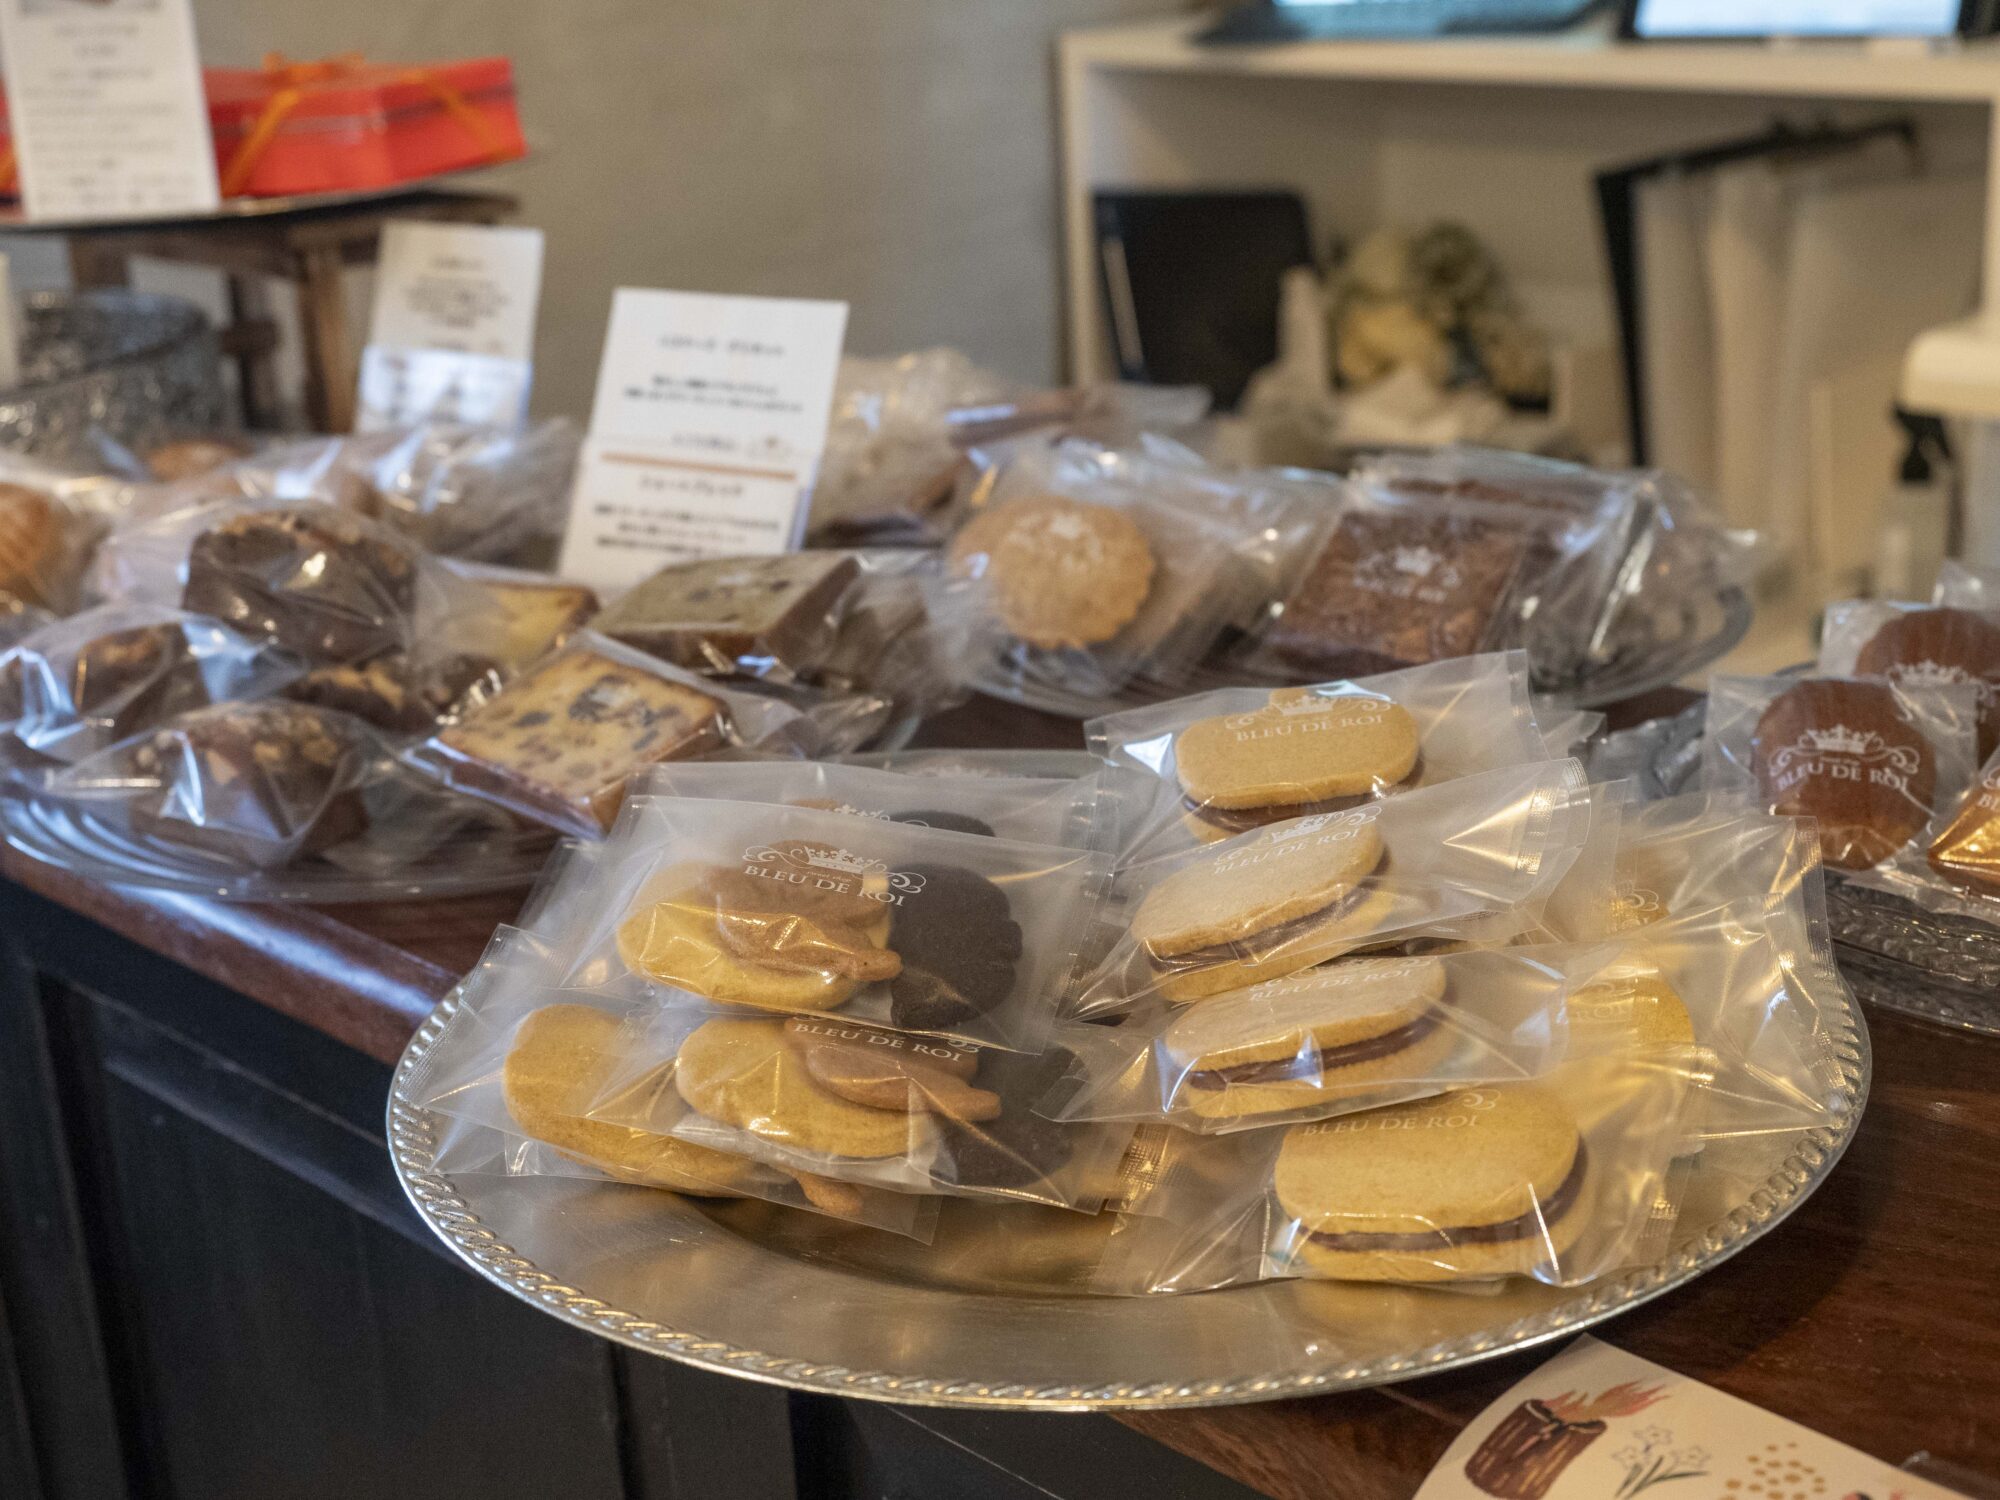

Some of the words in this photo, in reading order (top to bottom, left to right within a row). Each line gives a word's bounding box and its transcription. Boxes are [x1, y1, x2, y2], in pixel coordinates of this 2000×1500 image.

[1236, 725, 1293, 742] BLEU
[1302, 721, 1332, 733] DE
[1342, 715, 1383, 728] ROI
[1777, 762, 1824, 791] BLEU
[1831, 764, 1861, 781] DE
[1870, 768, 1910, 790] ROI
[1316, 828, 1361, 846] ROI
[743, 865, 807, 885] BLEU
[815, 879, 850, 895] DE
[857, 886, 906, 907] ROI
[1250, 983, 1313, 1001] BLEU
[1320, 978, 1354, 989] DE
[1363, 969, 1413, 982] ROI
[794, 1023, 860, 1040] BLEU
[867, 1035, 905, 1048] DE
[912, 1043, 963, 1062] ROI
[1303, 1119, 1370, 1136] BLEU
[1378, 1117, 1417, 1130] DE
[1425, 1115, 1478, 1129] ROI
